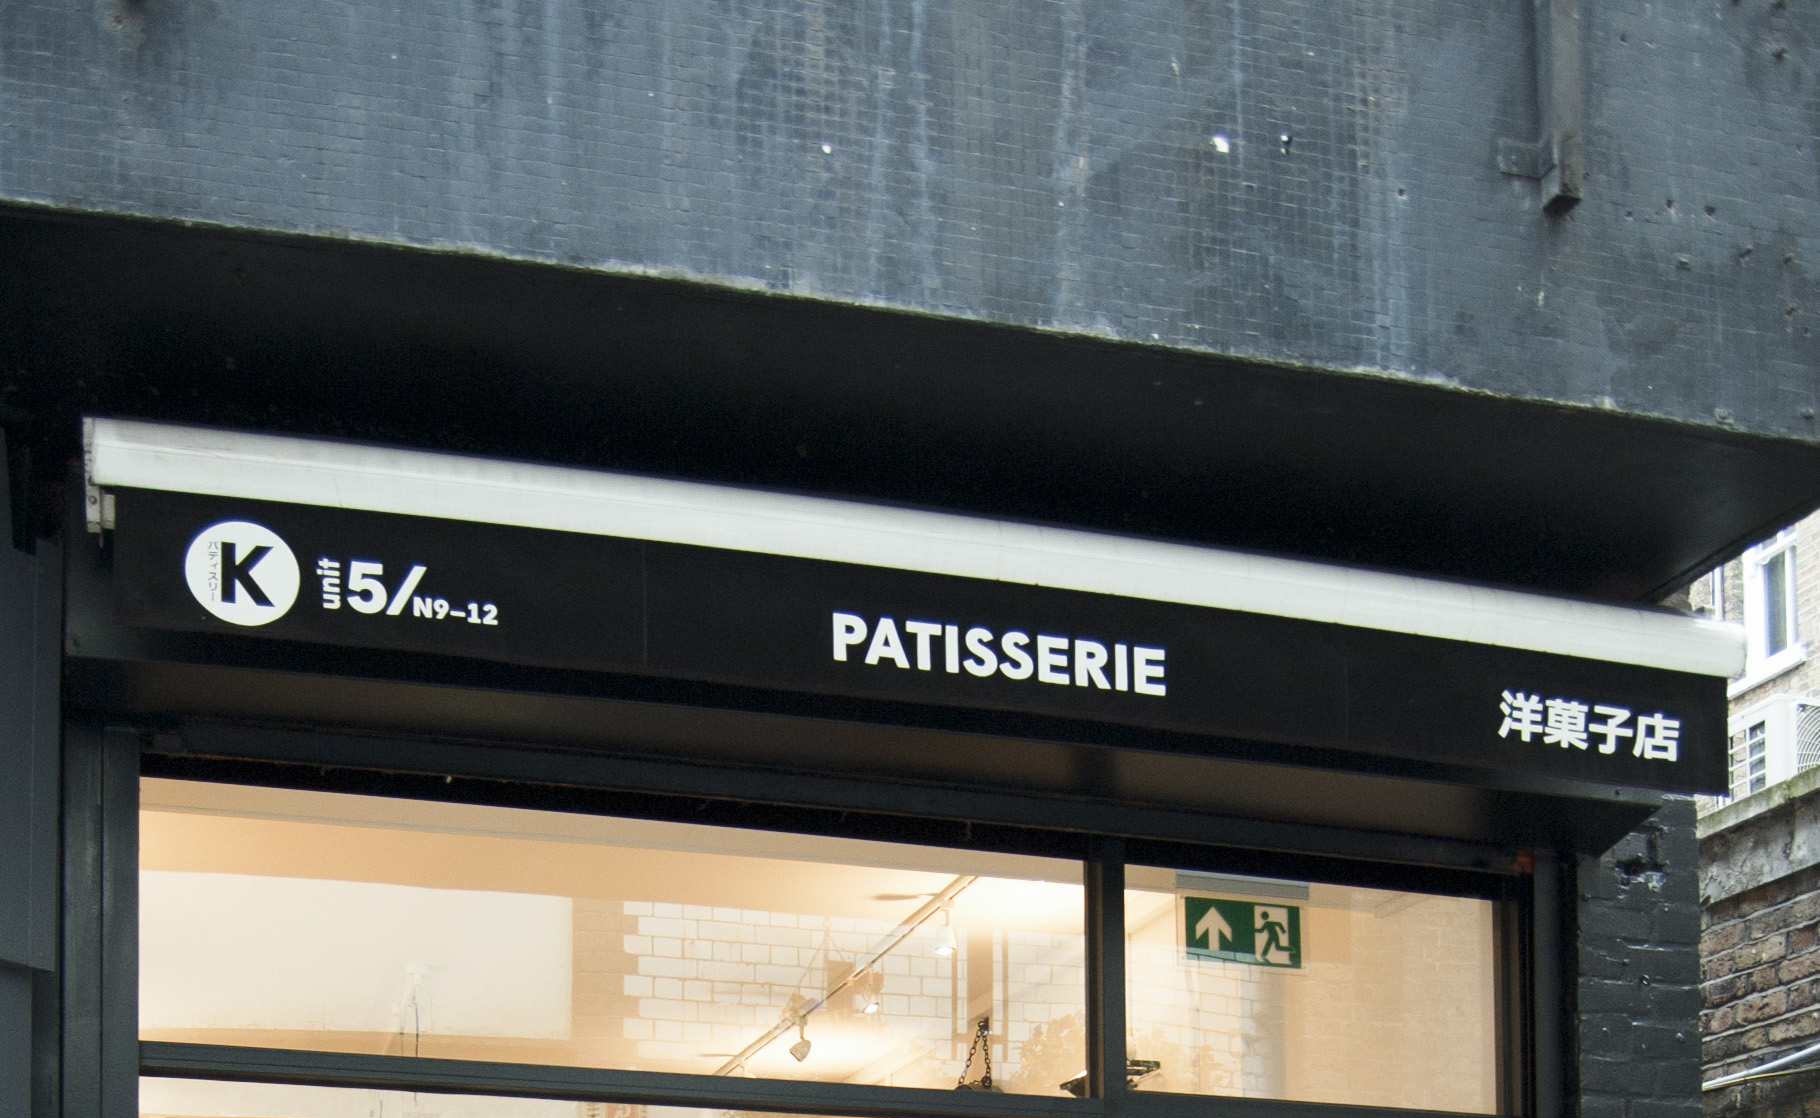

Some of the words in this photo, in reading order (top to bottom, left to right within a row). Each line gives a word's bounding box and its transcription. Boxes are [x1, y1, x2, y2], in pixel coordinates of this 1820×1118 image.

[220, 541, 276, 608] K
[316, 557, 341, 610] unit
[832, 612, 1167, 697] PATISSERIE
[1497, 689, 1681, 762] 洋菓子店
